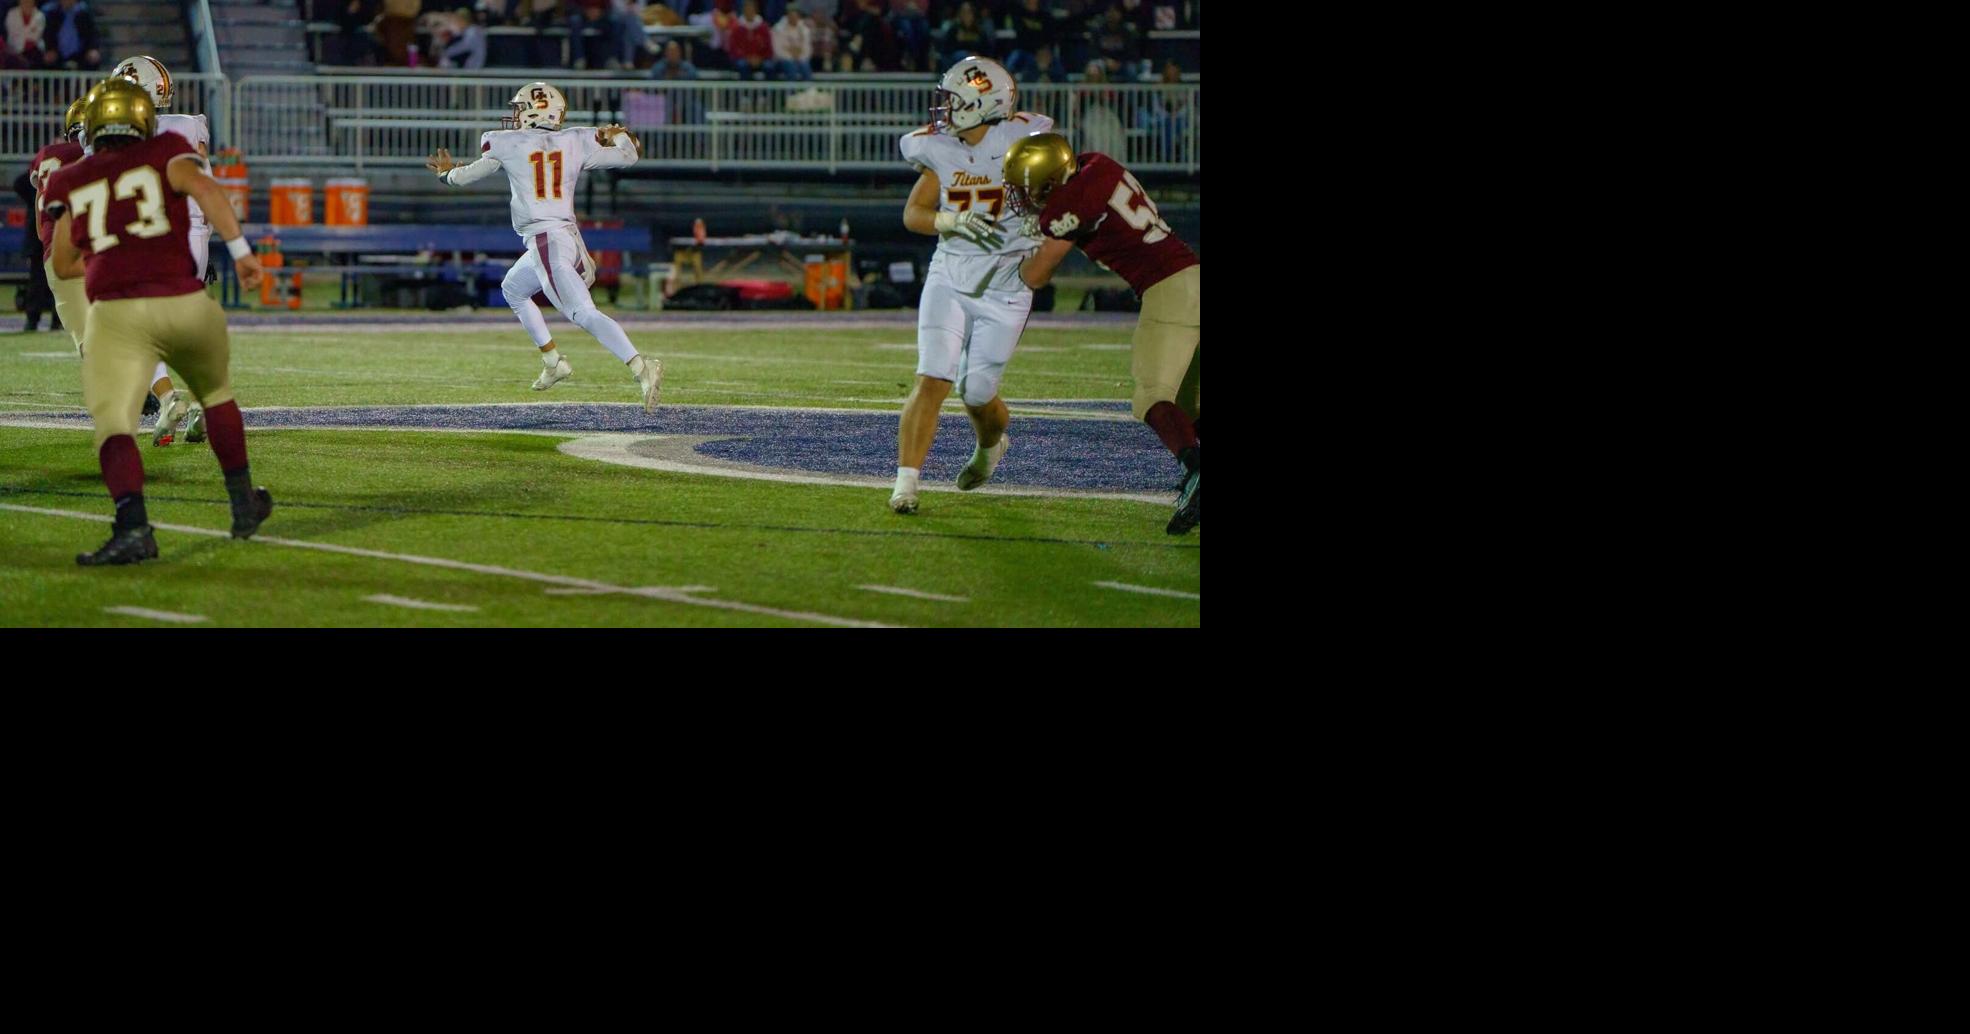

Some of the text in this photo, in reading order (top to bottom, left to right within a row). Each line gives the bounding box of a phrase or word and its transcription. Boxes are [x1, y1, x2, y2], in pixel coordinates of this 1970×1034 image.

[528, 150, 563, 201] 11
[951, 170, 992, 187] Titans
[68, 164, 171, 254] 73
[946, 186, 1005, 218] 77
